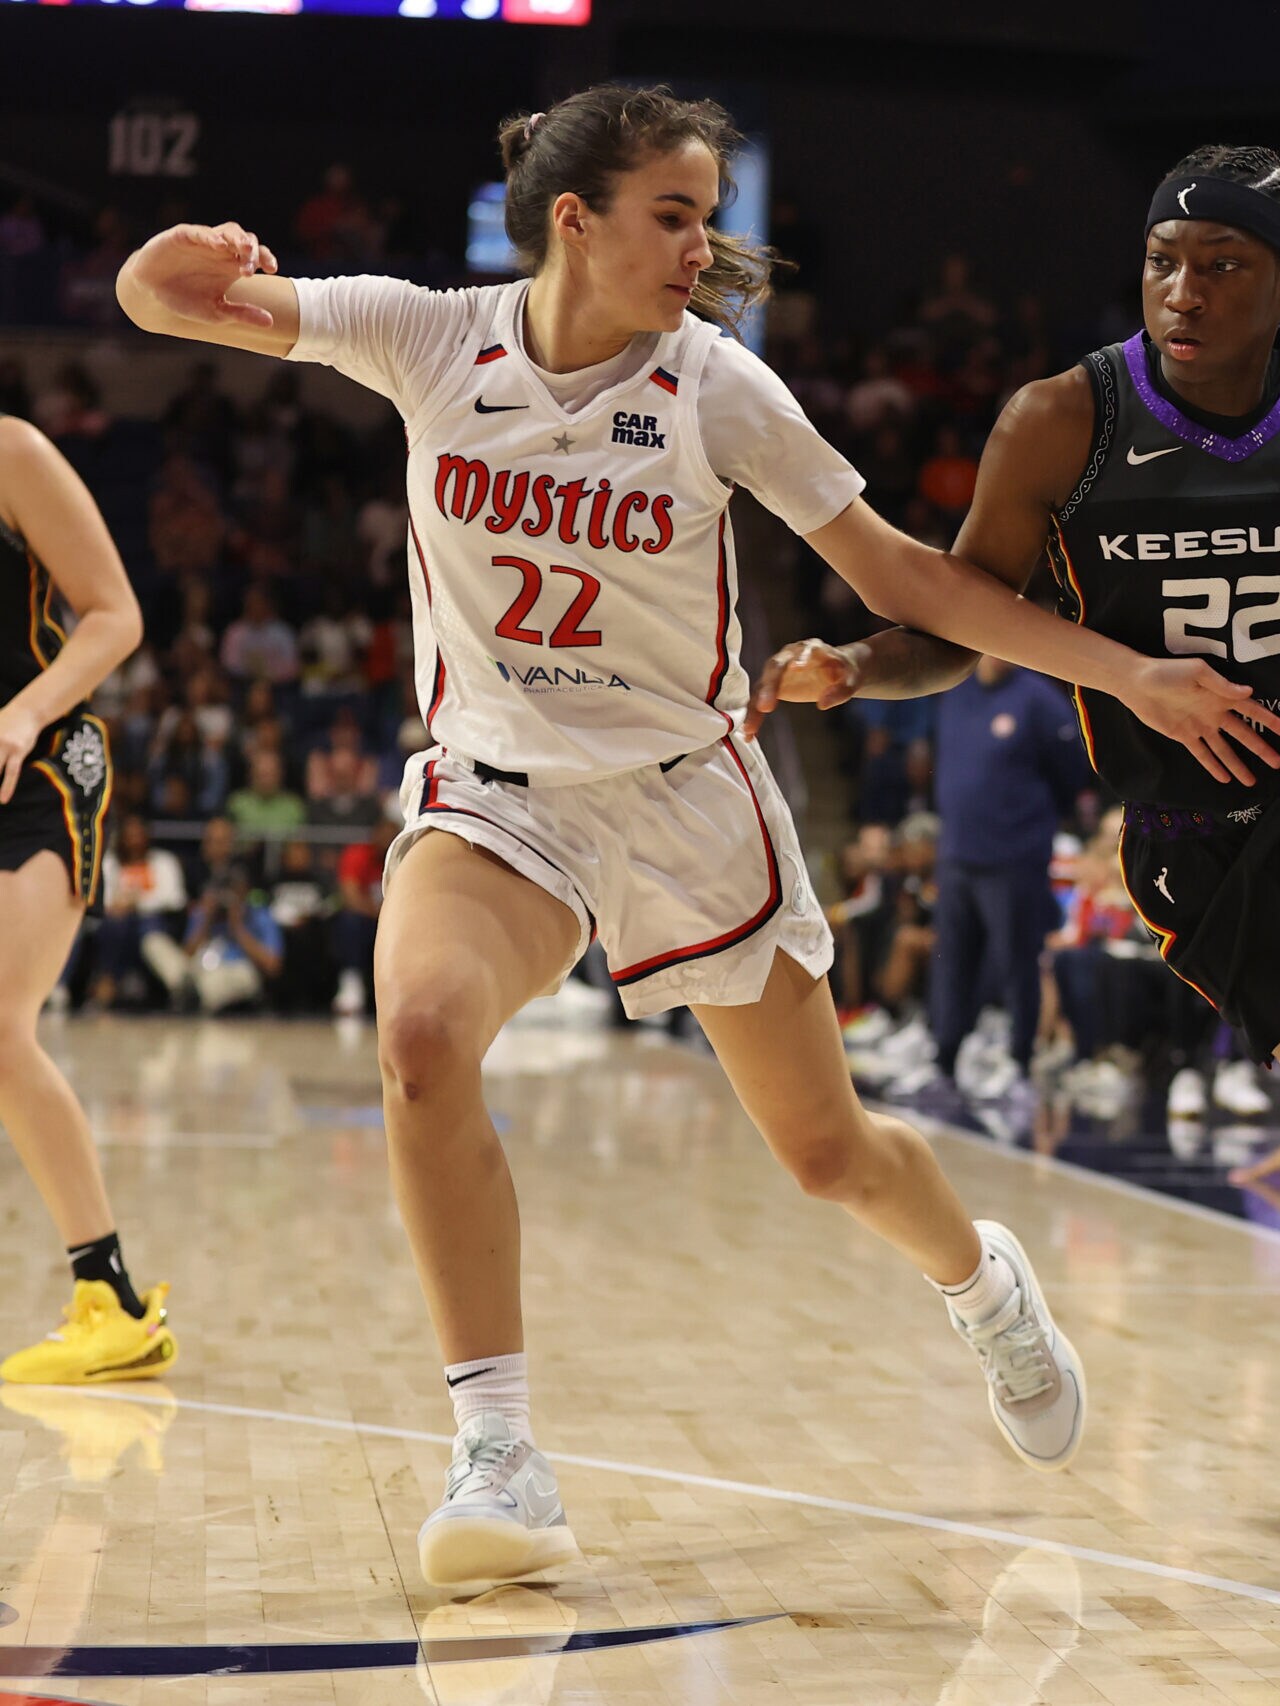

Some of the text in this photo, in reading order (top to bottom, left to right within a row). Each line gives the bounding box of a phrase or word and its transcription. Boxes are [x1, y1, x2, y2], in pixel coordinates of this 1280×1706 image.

[109, 112, 200, 177] 102
[611, 427, 666, 449] max
[612, 411, 658, 432] CAR
[491, 555, 603, 648] 22
